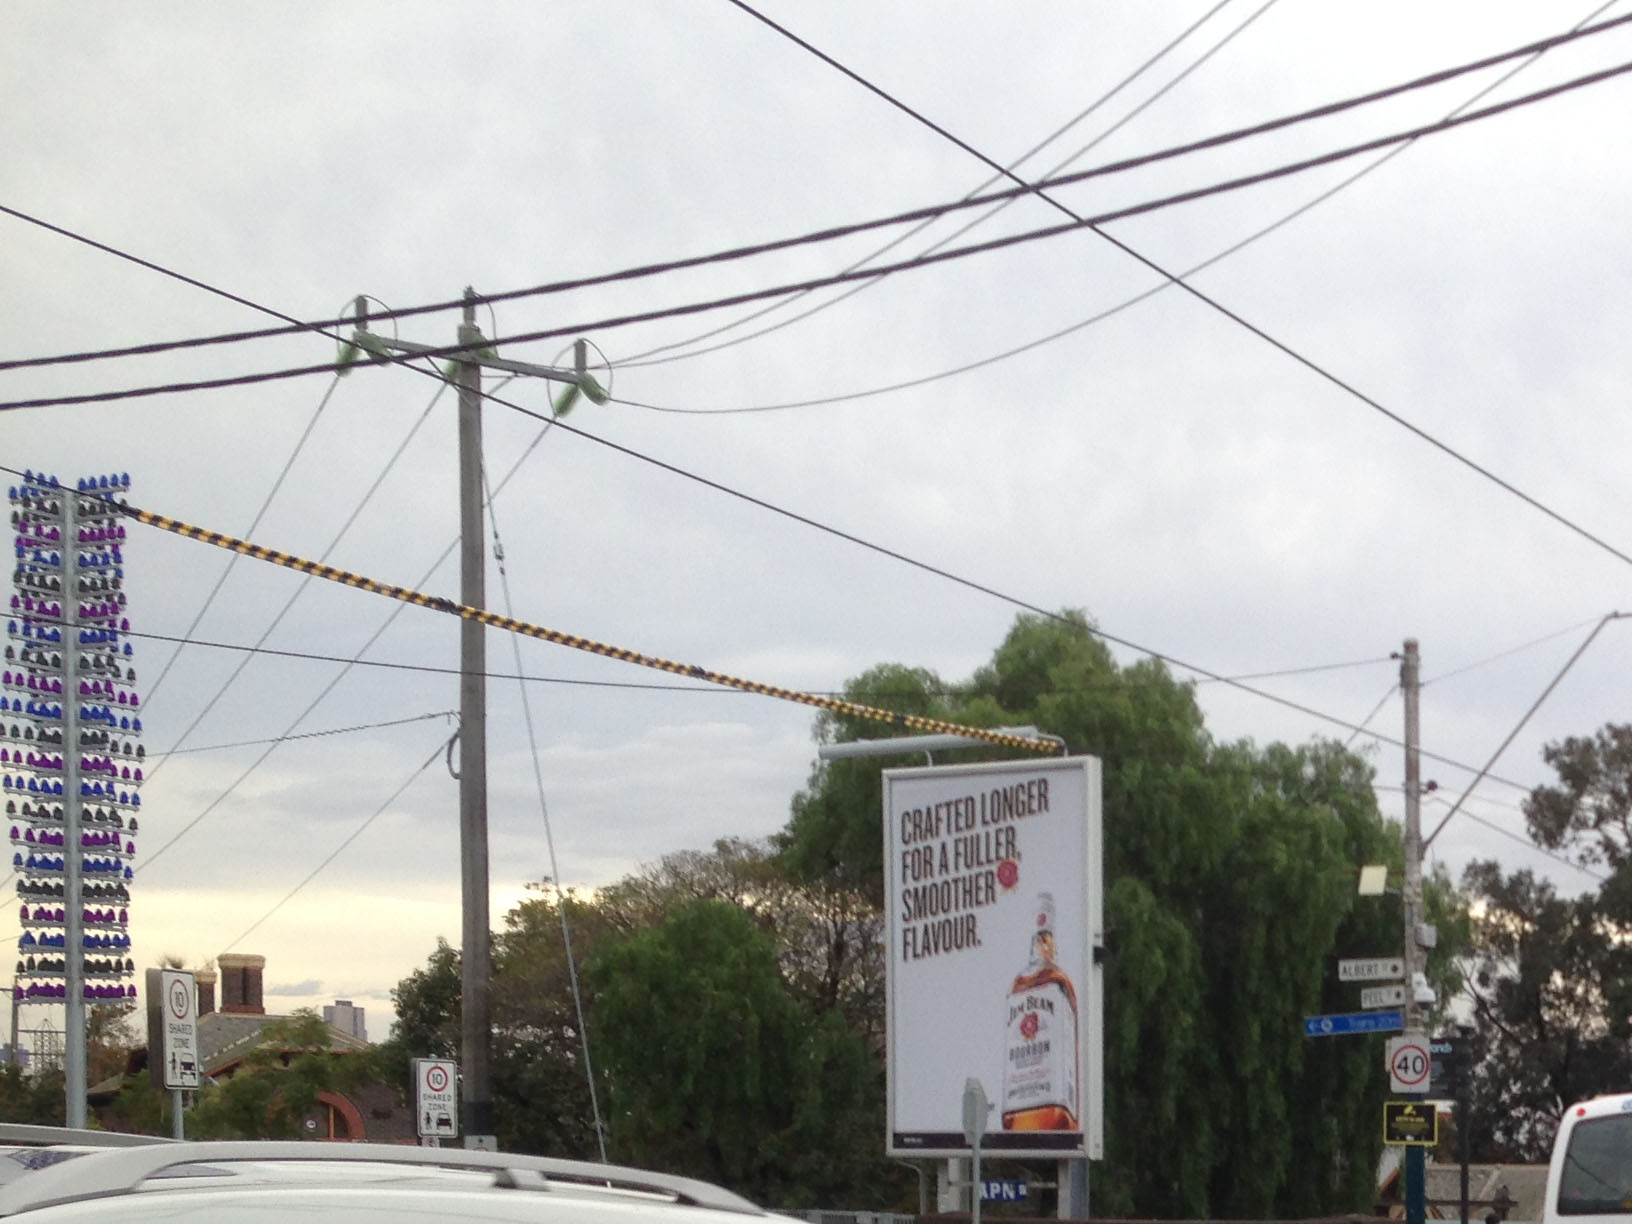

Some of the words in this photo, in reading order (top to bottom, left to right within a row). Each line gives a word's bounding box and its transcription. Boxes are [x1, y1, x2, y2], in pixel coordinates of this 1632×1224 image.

[901, 796, 976, 846] CRAFTED
[980, 777, 1049, 827] LONGER
[901, 844, 934, 885] FOR
[938, 841, 949, 876] A
[953, 826, 1022, 872] FULLER,
[901, 869, 996, 923] SMOOTHER
[901, 913, 982, 962] FLAVOUR.
[1342, 963, 1378, 977] ALBERT
[174, 991, 185, 1010] 10
[1026, 995, 1055, 1016] BEAM
[169, 1023, 193, 1036] SHARED
[1397, 1055, 1424, 1075] 40
[432, 1073, 443, 1086] 10
[423, 1093, 452, 1102] SHARED
[428, 1102, 448, 1111] ZONE
